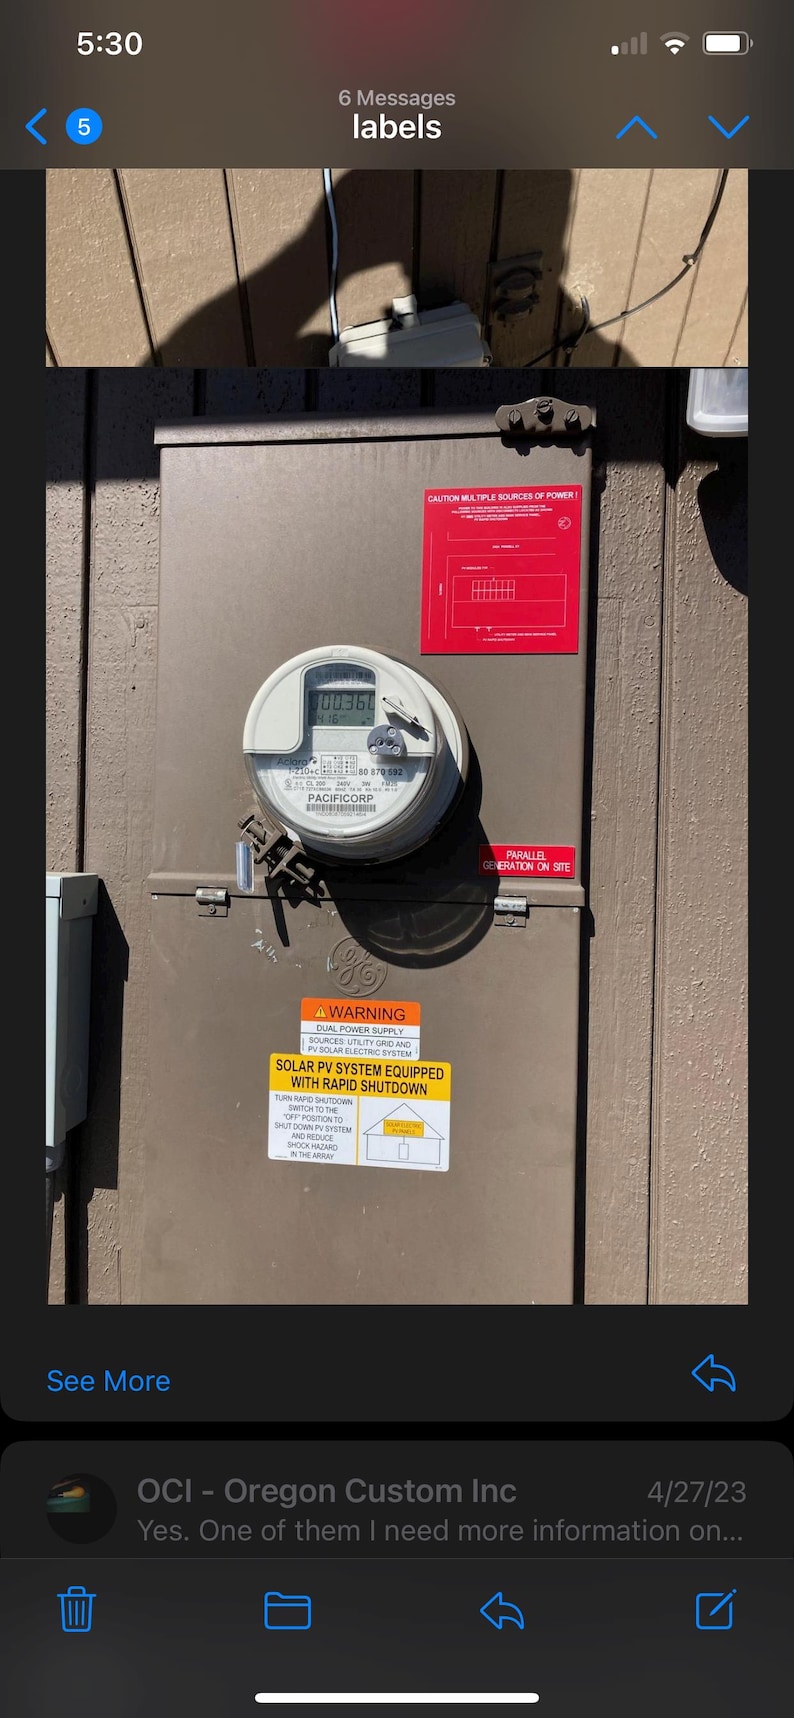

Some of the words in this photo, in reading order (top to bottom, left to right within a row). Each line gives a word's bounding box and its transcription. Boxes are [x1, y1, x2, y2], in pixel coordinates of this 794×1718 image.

[77, 31, 143, 56] 5:30
[339, 90, 351, 107] 6
[357, 90, 456, 110] Messages
[77, 118, 91, 137] 5
[353, 114, 442, 140] labels
[428, 494, 460, 503] CAUTION
[461, 493, 496, 502] MULTIPLE
[498, 493, 533, 501] SOURCES
[535, 492, 545, 500] OF
[546, 491, 574, 499] POWER
[358, 768, 369, 776] 80
[371, 768, 386, 776] 870
[388, 768, 403, 776] 592
[308, 793, 374, 803] PACIFICORP
[506, 850, 547, 861] PARALLEL
[482, 860, 534, 871] GENERATION
[537, 862, 550, 872] ON
[553, 862, 571, 872] SITE
[329, 1005, 406, 1021] WARNING
[316, 1024, 338, 1033] DUAL
[339, 1025, 370, 1034] POWER
[372, 1026, 404, 1036] SUPPLY
[309, 1036, 346, 1046] SOURCES:
[347, 1038, 374, 1047] UTILITY
[376, 1039, 394, 1048] GRID
[395, 1040, 411, 1048] AND
[307, 1045, 318, 1053] PV
[319, 1046, 344, 1055] SOLAR
[345, 1047, 381, 1056] ELECTRIC
[382, 1049, 412, 1058] SYSTEM
[276, 1059, 314, 1073] SOLAR
[317, 1061, 333, 1074] PV
[336, 1062, 382, 1077] SYSTEM
[386, 1065, 444, 1080] EQUIPPED
[291, 1075, 319, 1089] WITH
[323, 1077, 357, 1091] RAPID
[361, 1079, 427, 1096] SHUTDOWN
[275, 1094, 292, 1102] TURN
[294, 1095, 314, 1103] RAPID
[315, 1096, 353, 1106] SHUTDOWN
[288, 1104, 312, 1113] SWITCH
[313, 1105, 324, 1113] TO
[326, 1106, 338, 1114] THE
[301, 1114, 333, 1123] POSITION
[334, 1116, 343, 1124] TO
[274, 1121, 292, 1130] SHUT
[293, 1122, 313, 1131] DOWN
[314, 1124, 324, 1132] PV
[324, 1124, 352, 1133] SYSTEM
[291, 1132, 305, 1140] AND
[306, 1133, 334, 1142] REDUCE
[287, 1141, 310, 1150] SHOCK
[311, 1142, 338, 1151] HAZARD
[299, 1151, 312, 1159] THE
[312, 1152, 335, 1161] ARRAY
[47, 1369, 95, 1393] See
[104, 1369, 171, 1393] More
[137, 1477, 192, 1504] OCI
[224, 1477, 336, 1509] Oregon
[345, 1477, 463, 1504] Custom
[472, 1478, 517, 1503] Inc
[647, 1479, 747, 1507] 4/27/23
[137, 1519, 189, 1542] Yes.
[199, 1519, 253, 1542] One
[261, 1518, 287, 1542] of
[294, 1518, 360, 1542] them
[370, 1519, 375, 1542] I
[385, 1518, 449, 1542] need
[458, 1524, 524, 1542] more
[533, 1518, 680, 1542] information
